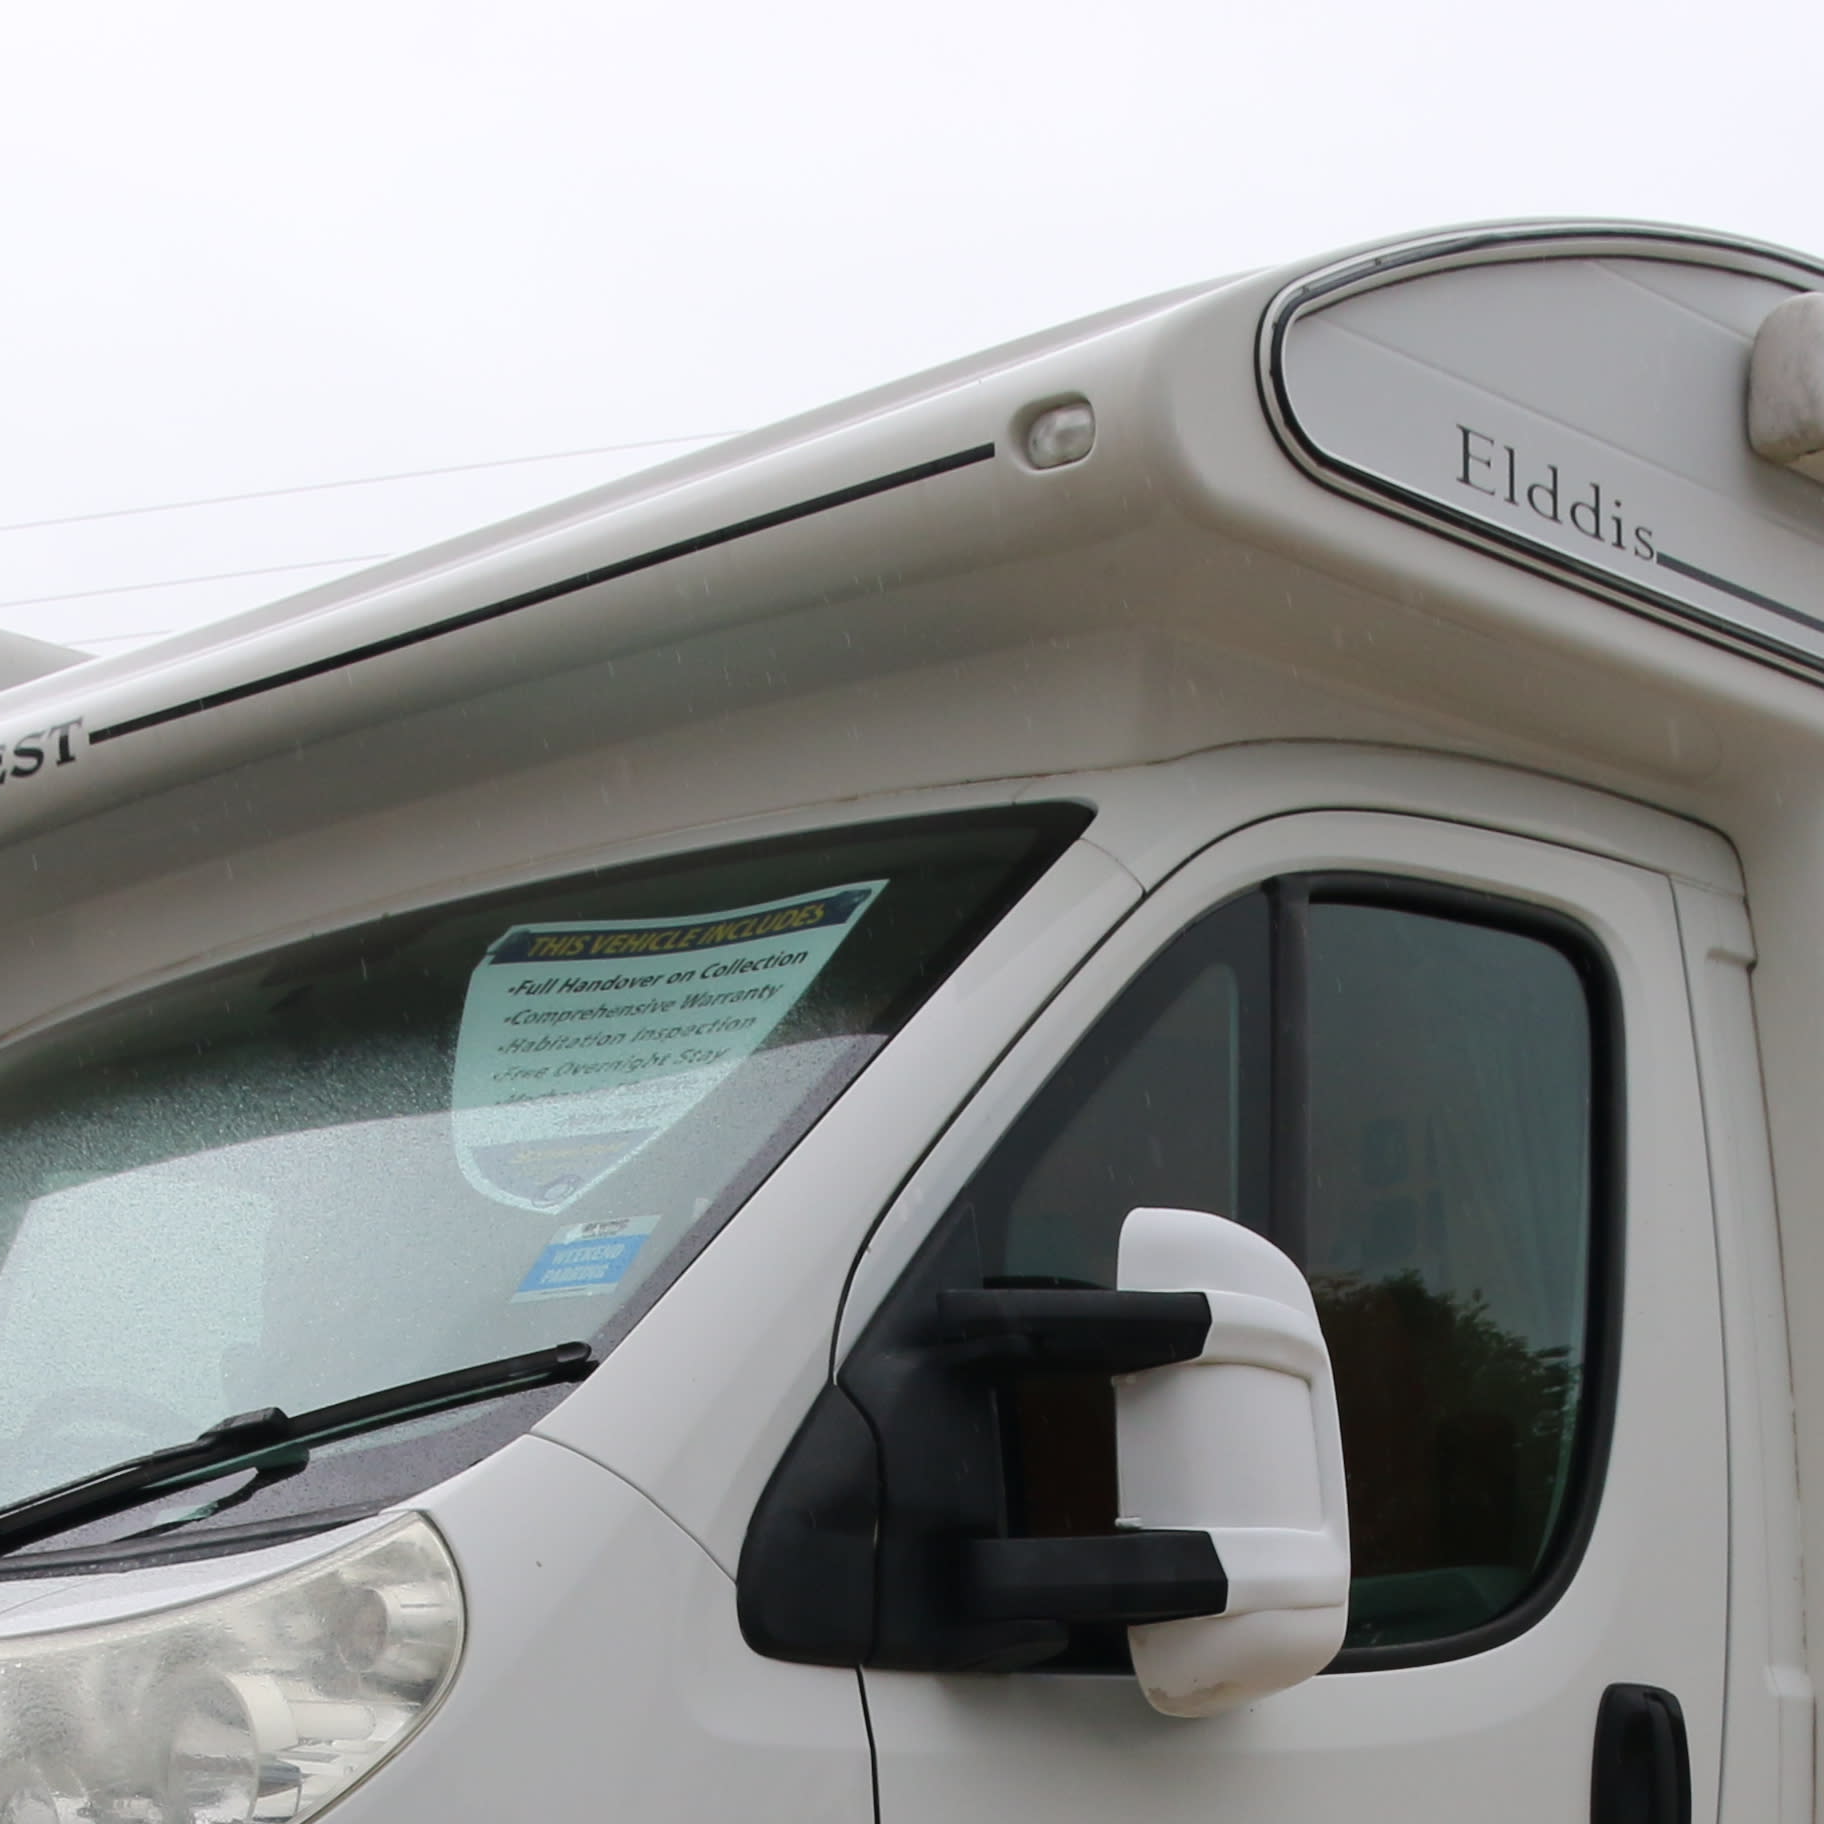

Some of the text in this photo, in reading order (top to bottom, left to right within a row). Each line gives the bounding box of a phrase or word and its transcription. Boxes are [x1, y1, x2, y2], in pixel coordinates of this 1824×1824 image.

[1456, 423, 1655, 561] Elddis
[528, 903, 825, 957] THIS VEHICLE INCLUDES
[557, 973, 665, 994] Handover
[666, 969, 697, 985] on
[700, 951, 809, 980] Collection
[679, 983, 785, 1010] Warranty
[631, 1017, 757, 1043] Inspection
[553, 1052, 672, 1077] Overnight
[674, 1048, 731, 1066] Stay
